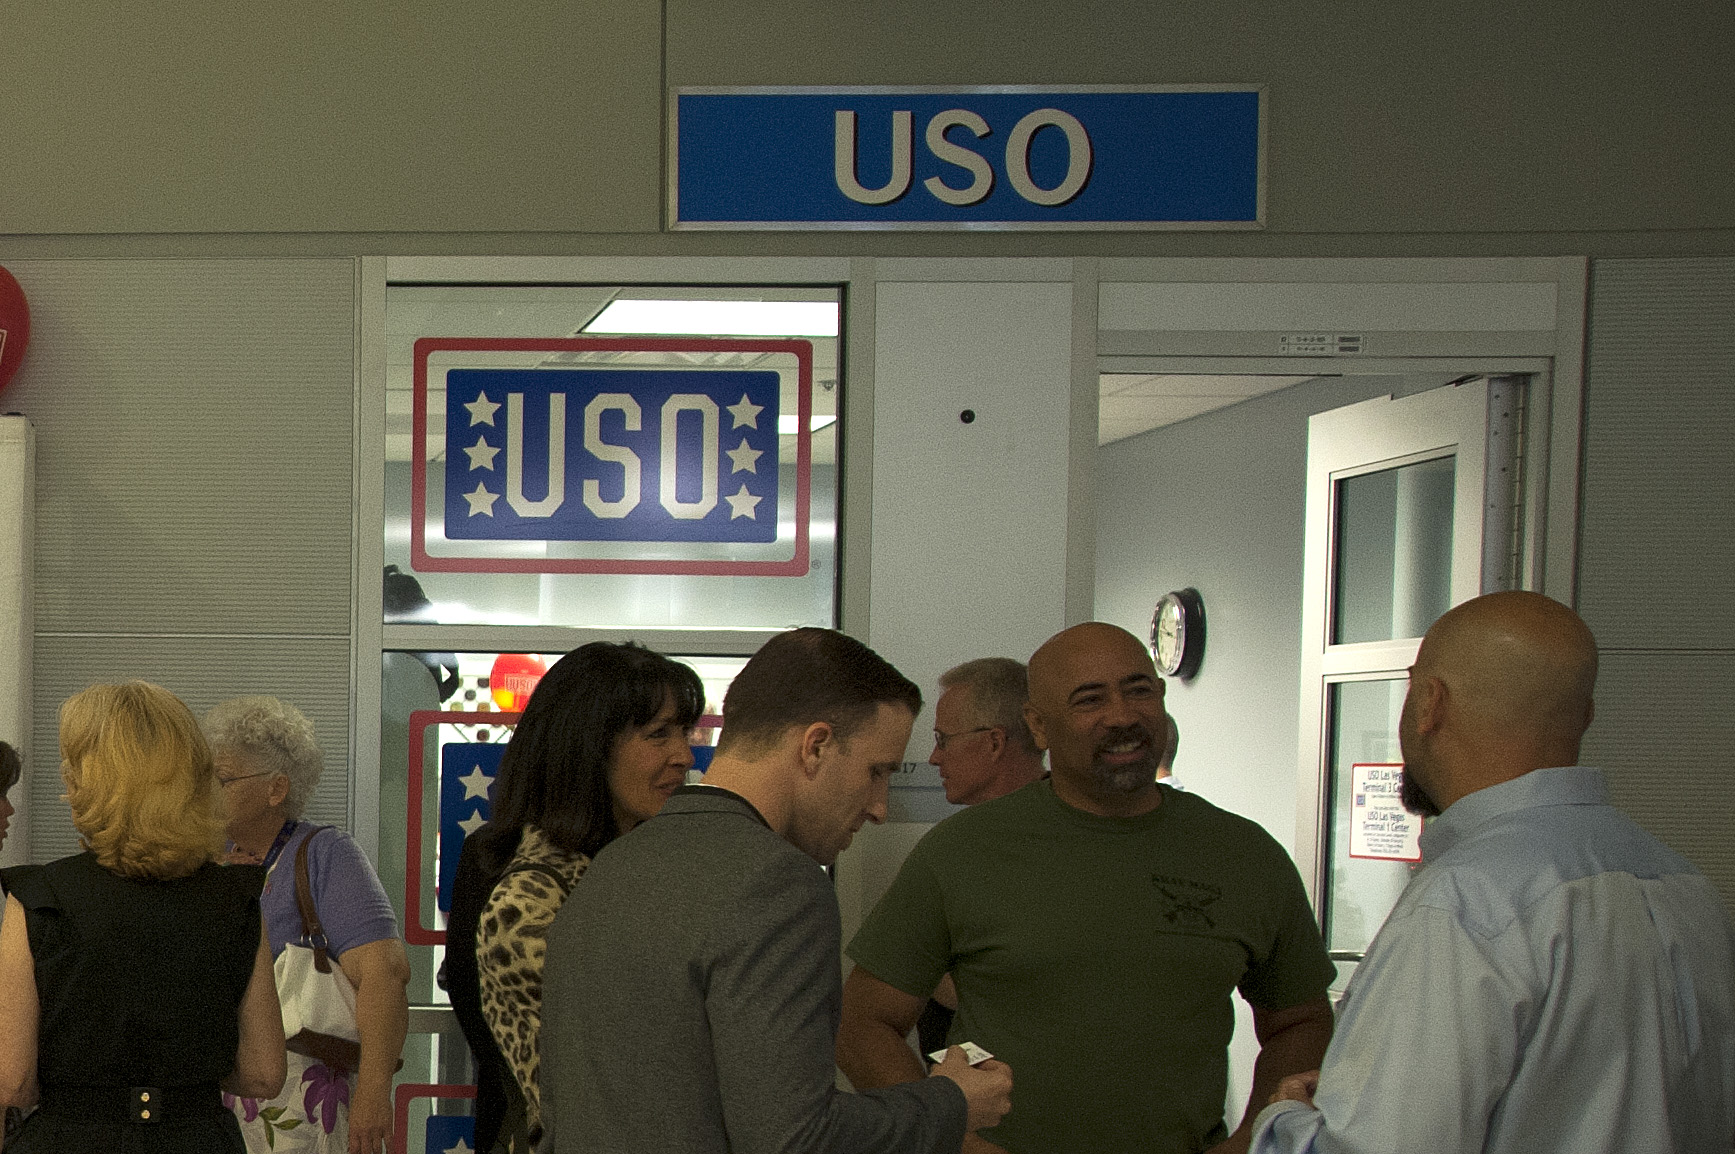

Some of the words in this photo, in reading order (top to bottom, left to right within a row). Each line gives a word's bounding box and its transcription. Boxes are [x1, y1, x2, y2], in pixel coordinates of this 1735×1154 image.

[835, 108, 1094, 207] USO
[507, 393, 719, 519] USO
[1368, 770, 1379, 780] USO
[1368, 811, 1379, 820] USO
